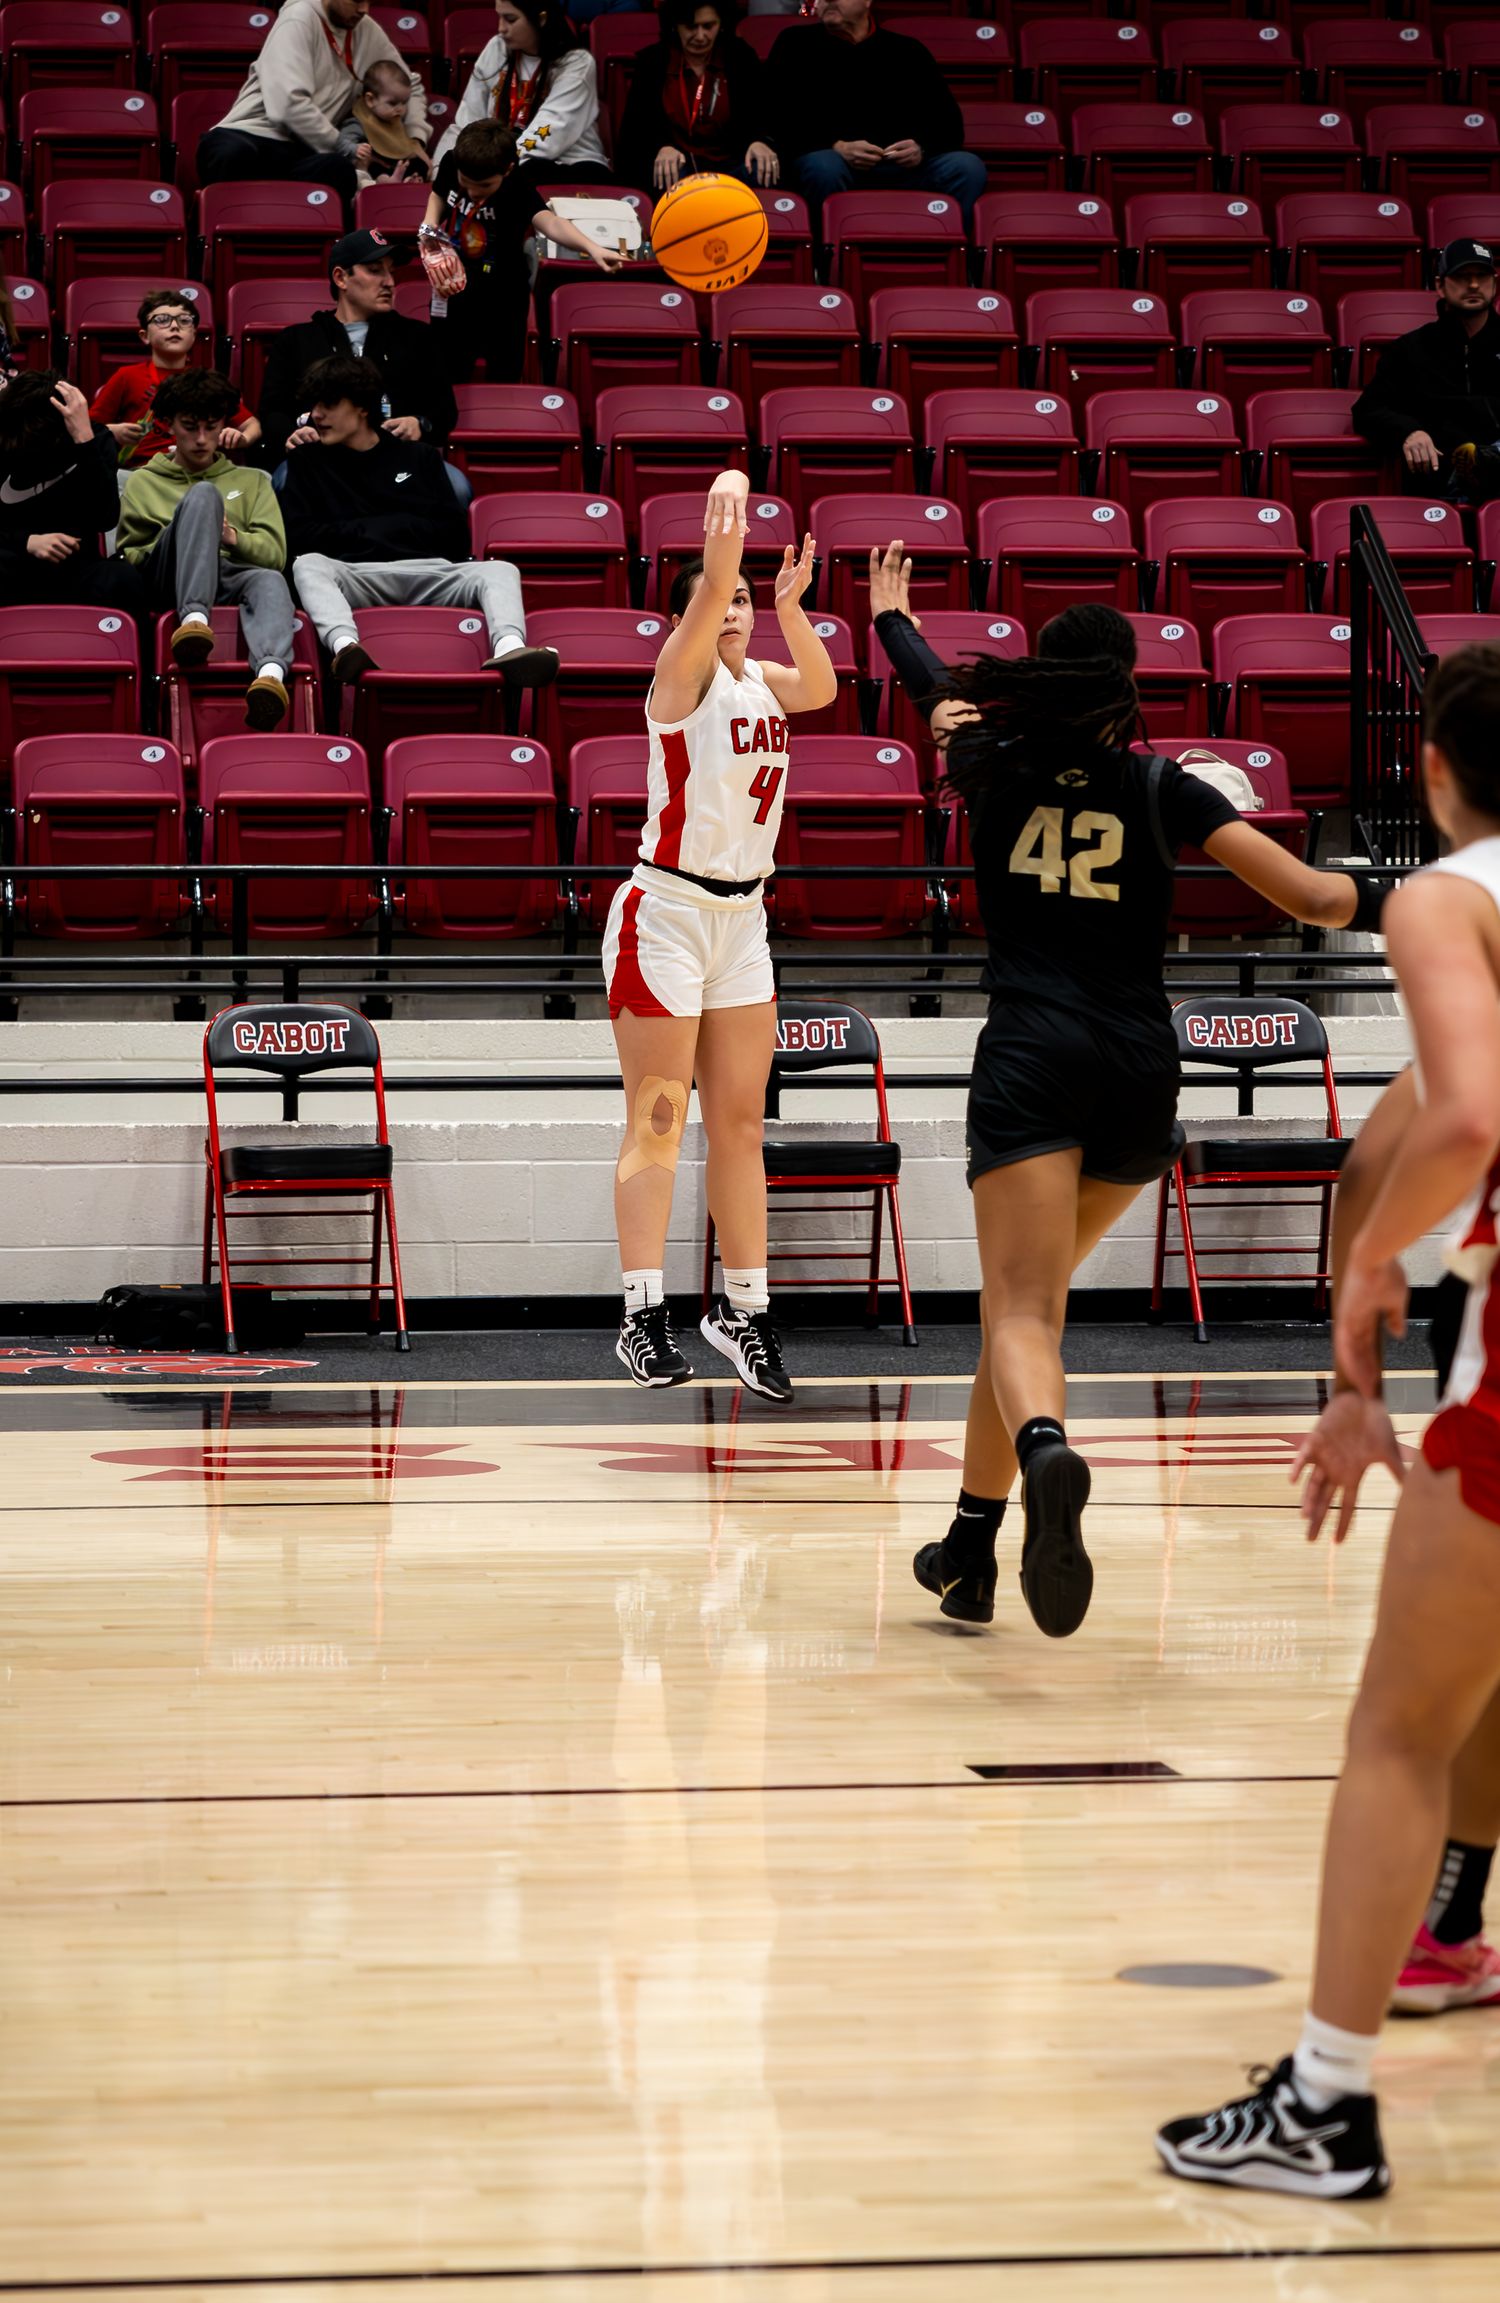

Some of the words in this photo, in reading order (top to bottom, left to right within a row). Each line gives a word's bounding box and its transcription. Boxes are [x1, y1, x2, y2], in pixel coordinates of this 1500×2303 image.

[932, 202, 944, 211] 10
[1083, 203, 1094, 212] 11
[982, 299, 995, 308] 10
[1138, 301, 1149, 310] 11
[1292, 301, 1304, 310] 12
[1040, 402, 1053, 411] 10
[1203, 402, 1213, 411] 11
[1098, 510, 1110, 519] 10
[1264, 511, 1274, 520] 11
[1429, 509, 1442, 519] 12
[1166, 627, 1179, 637] 10
[1336, 628, 1348, 637] 11
[1253, 754, 1267, 764] 10
[748, 765, 784, 826] 4
[1009, 806, 1124, 902] 42
[1185, 1012, 1299, 1048] CABOT
[232, 1018, 350, 1055] CABOT
